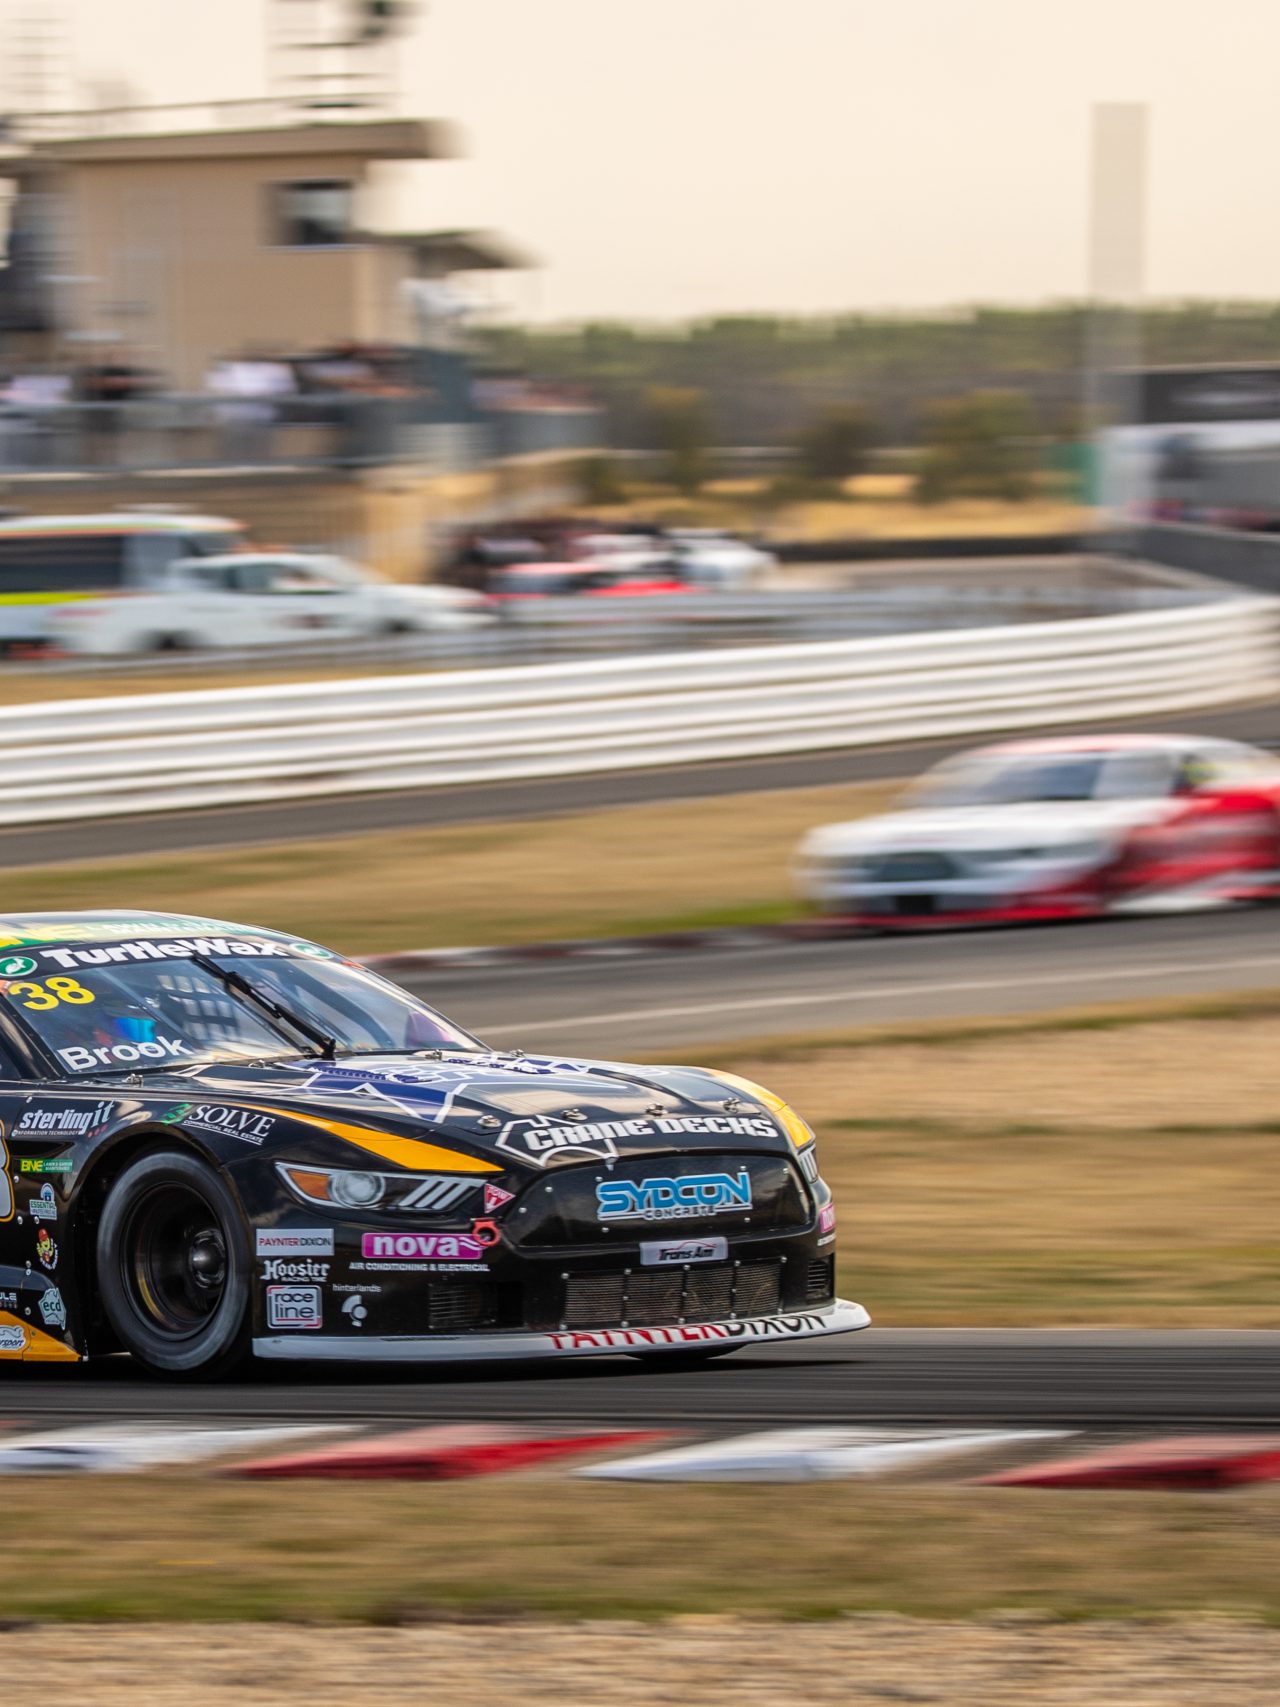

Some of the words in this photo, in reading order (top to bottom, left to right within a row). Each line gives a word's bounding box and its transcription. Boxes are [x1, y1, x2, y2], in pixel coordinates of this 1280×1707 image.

[8, 977, 95, 1011] 38
[57, 1036, 193, 1071] Brook
[189, 1104, 276, 1137] SOLVE
[16, 1129, 47, 1137] NFORMATION
[183, 1119, 222, 1131] COMMERCIAL
[223, 1126, 239, 1136] REAL
[240, 1131, 264, 1144] ESTATE
[523, 1119, 655, 1150] CRANE
[654, 1117, 778, 1138] DECKS
[21, 1160, 43, 1172] BNE
[487, 1185, 509, 1200] TOW
[596, 1171, 753, 1213] SYDCON
[643, 1206, 717, 1220] CONCRETE
[258, 1237, 332, 1247] PAYNTERDIXON
[373, 1236, 460, 1256] nova
[260, 1258, 331, 1280] Hoosier
[348, 1262, 364, 1270] AIR
[365, 1263, 427, 1271] CONDITIONING
[438, 1264, 490, 1272] ELECTRICAL
[274, 1293, 314, 1303] race
[275, 1303, 314, 1318] line
